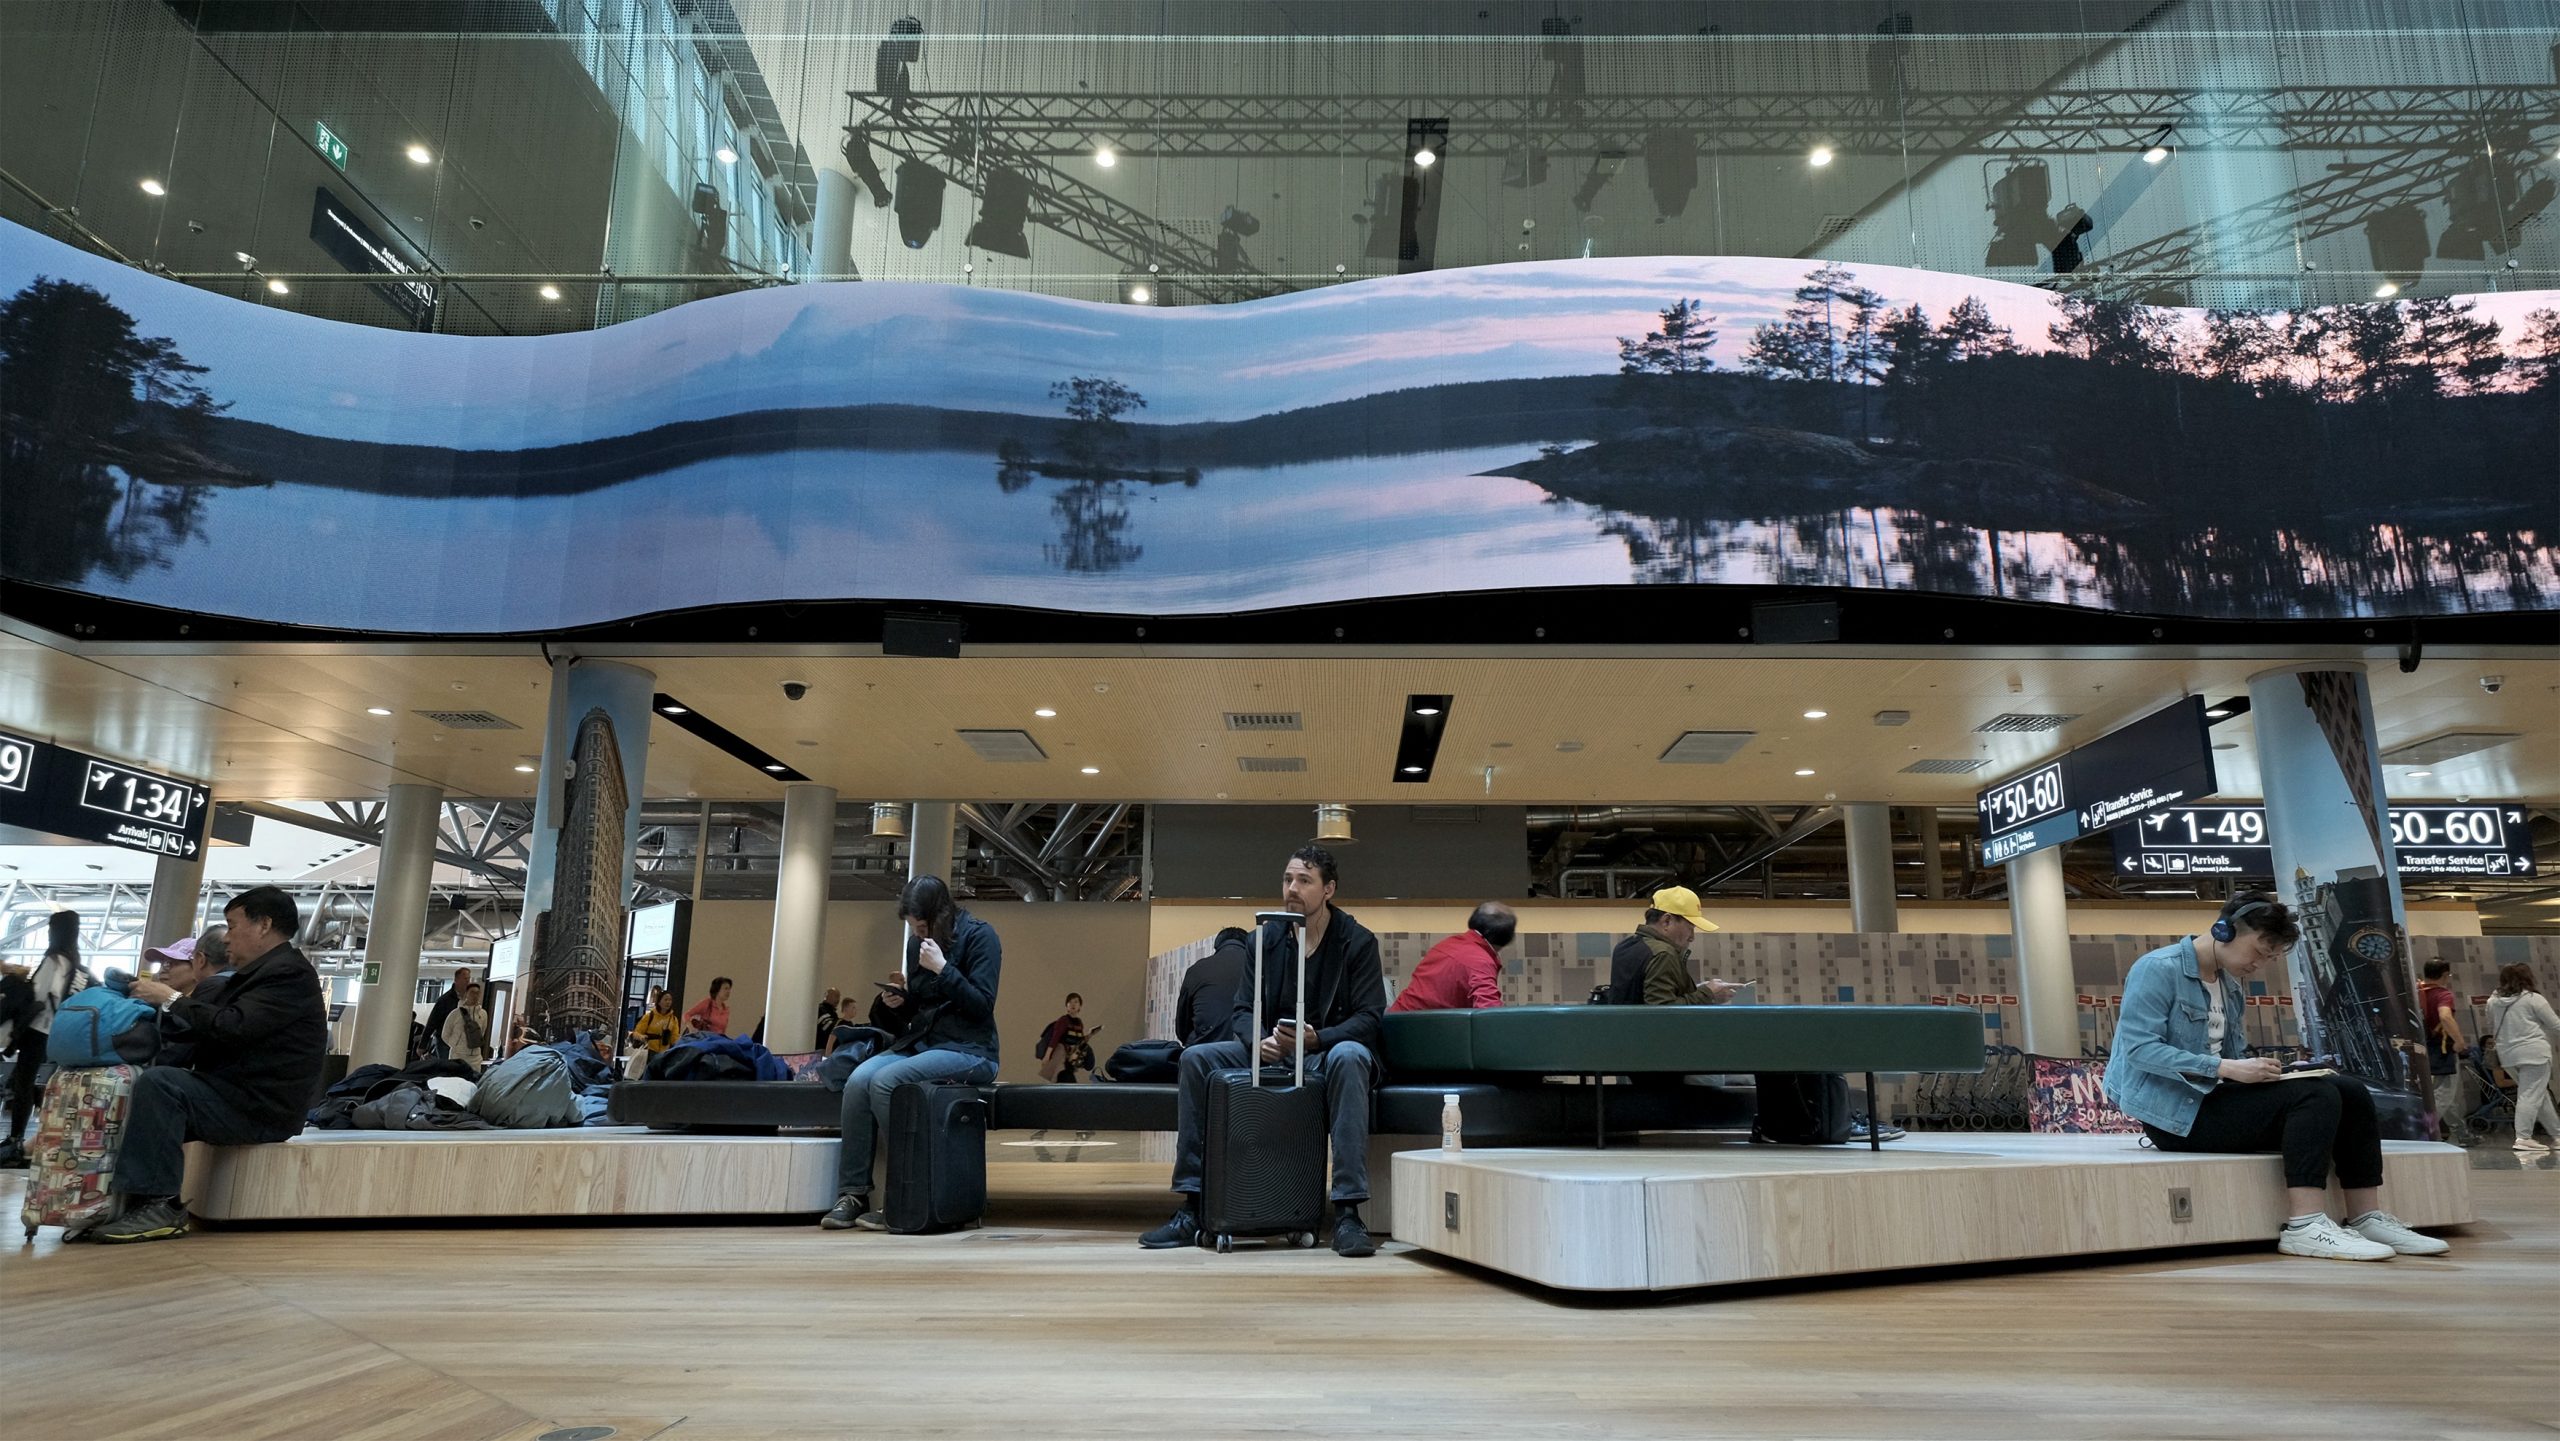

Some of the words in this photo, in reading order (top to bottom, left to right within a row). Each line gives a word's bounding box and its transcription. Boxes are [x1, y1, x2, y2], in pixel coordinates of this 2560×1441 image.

[123, 777, 183, 823] 1-34
[2005, 770, 2059, 823] 50-60
[2105, 796, 2129, 812] Transfer
[2129, 787, 2153, 805] Service
[119, 824, 149, 840] Arrivals
[2181, 811, 2264, 843] 1-49
[2389, 811, 2494, 844] 50-60
[2191, 855, 2230, 865] Arrivals
[2404, 855, 2446, 865] Transfer
[2448, 855, 2485, 865] Service
[2078, 1108, 2096, 1121] 50
